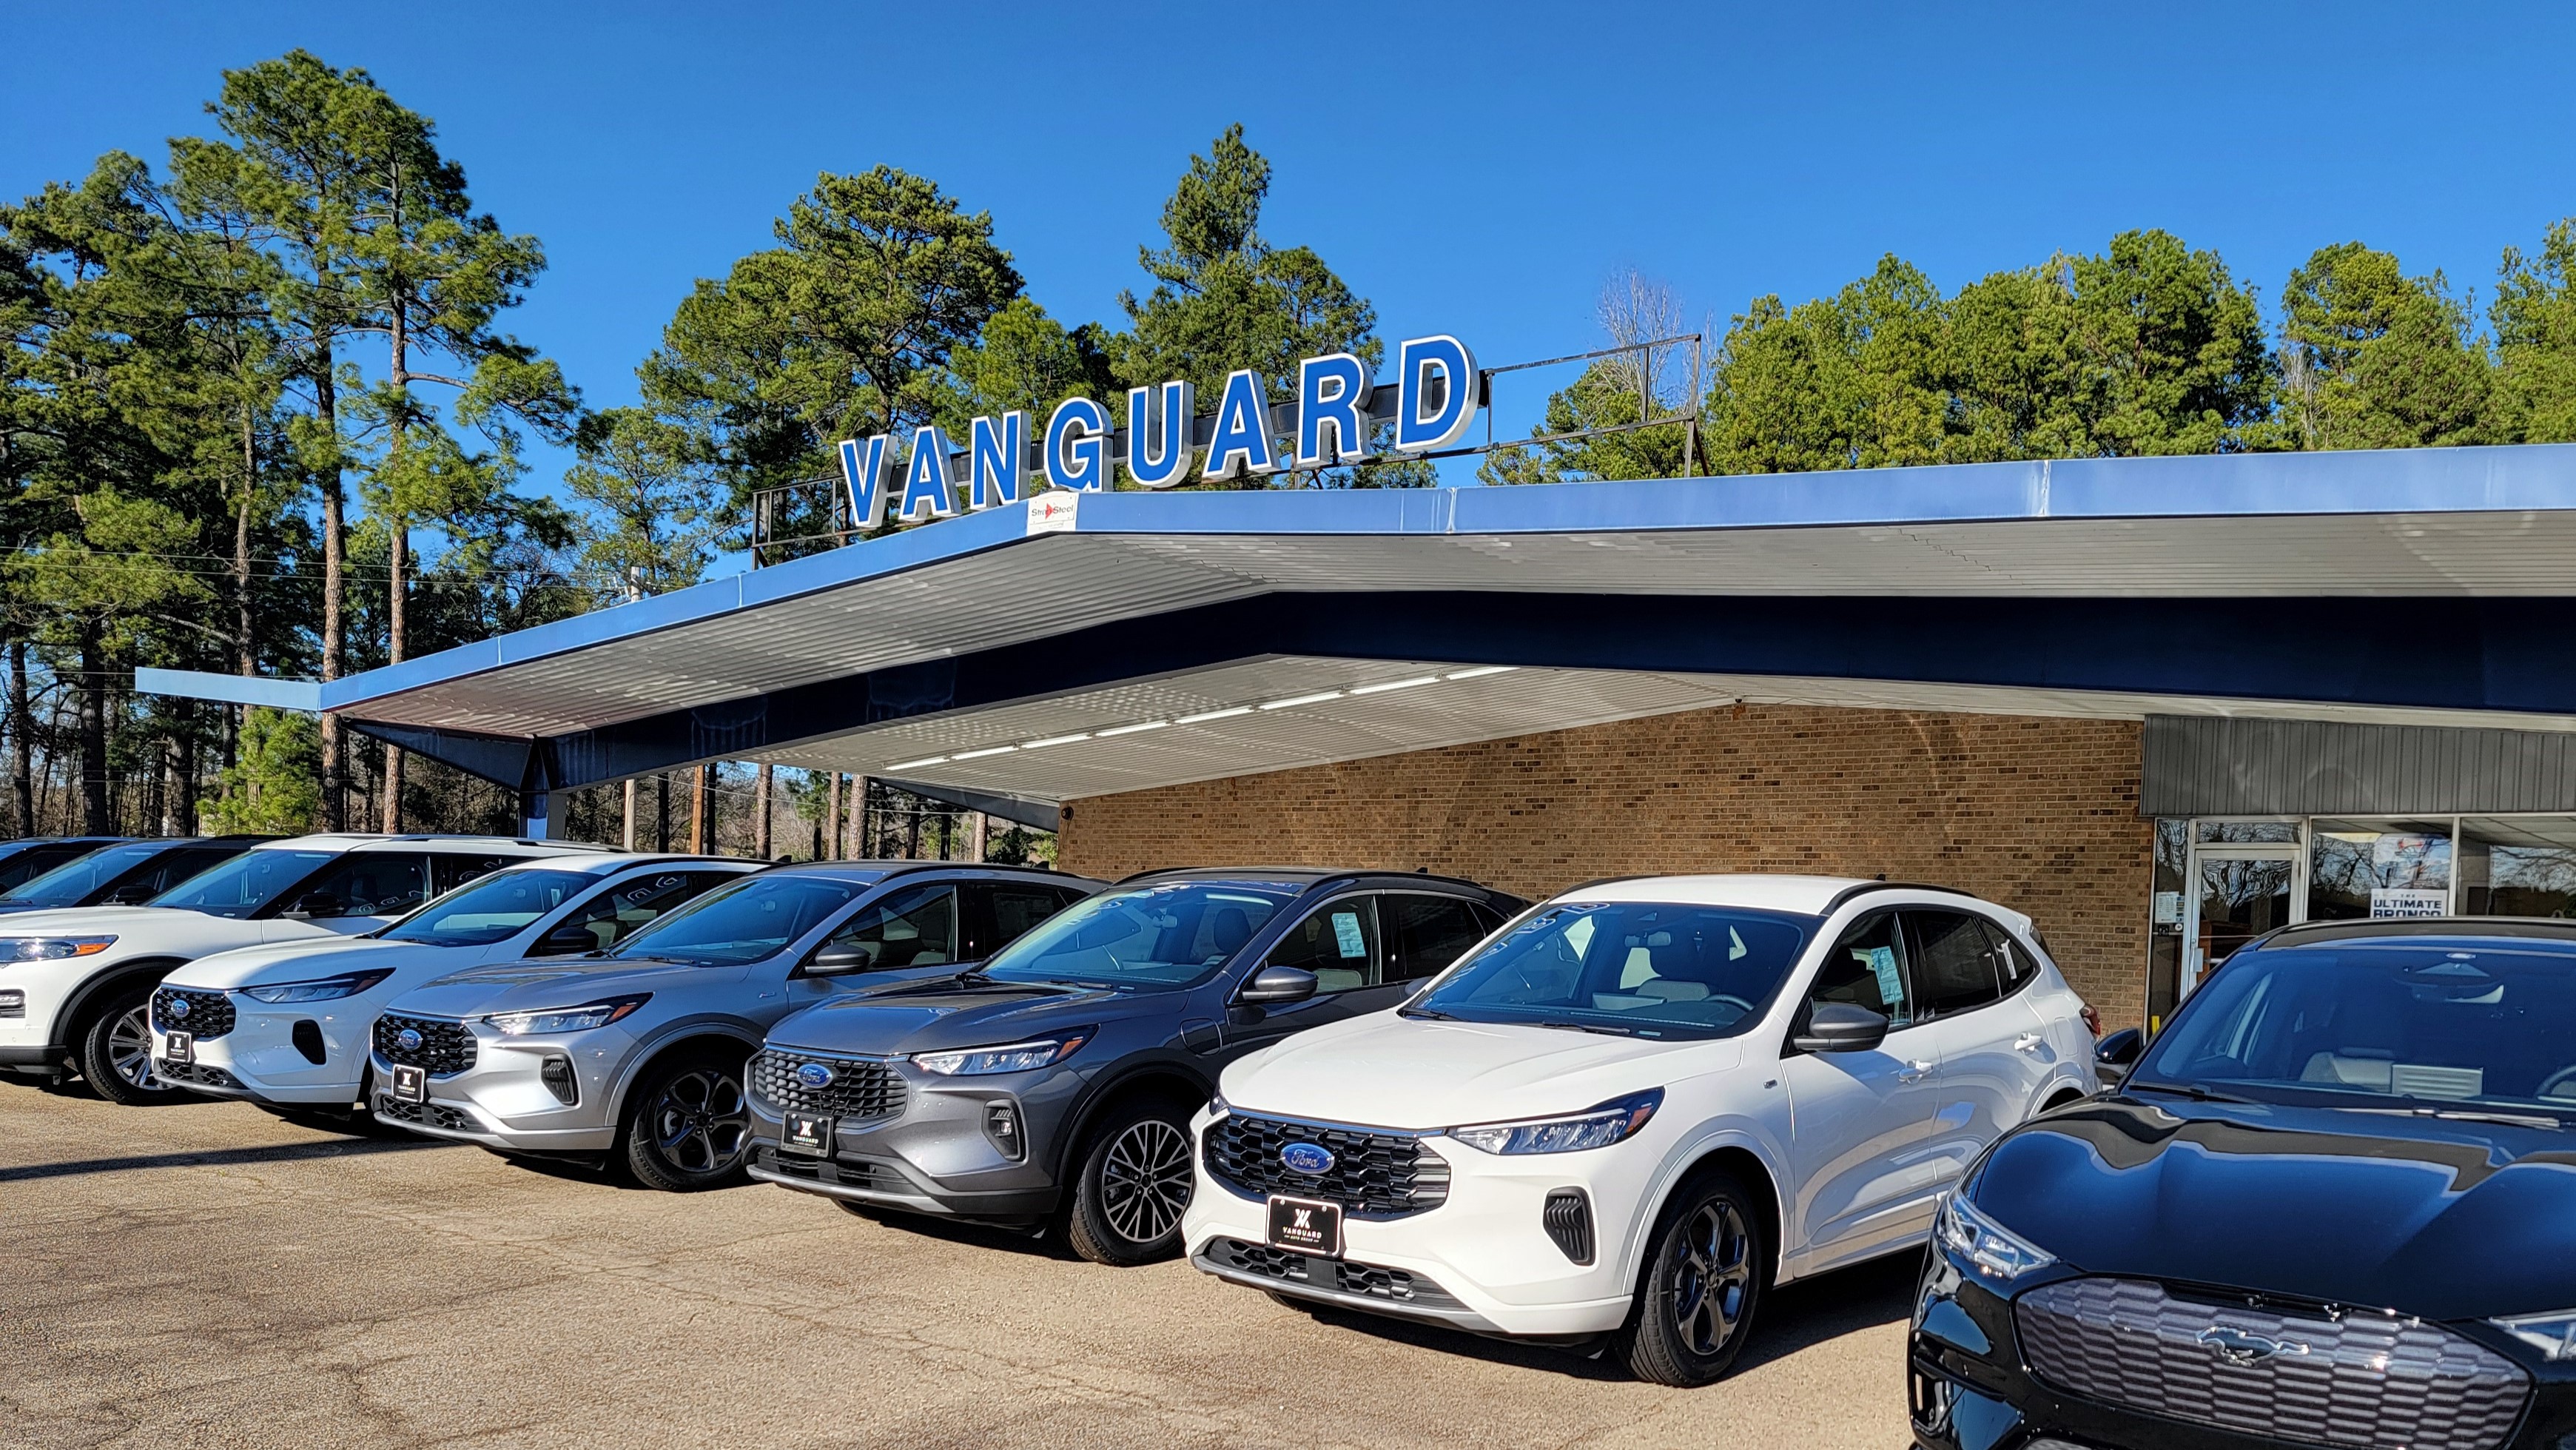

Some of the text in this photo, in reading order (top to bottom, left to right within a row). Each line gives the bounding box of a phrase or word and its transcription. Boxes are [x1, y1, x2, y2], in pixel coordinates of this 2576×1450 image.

[838, 335, 1478, 527] VANGUARD
[1053, 504, 1074, 514] Steel
[2373, 899, 2442, 909] ULTIMATE
[2373, 909, 2441, 918] BRONCO
[1291, 1149, 1321, 1168] Ford
[1282, 1226, 1322, 1239] VANGUARD
